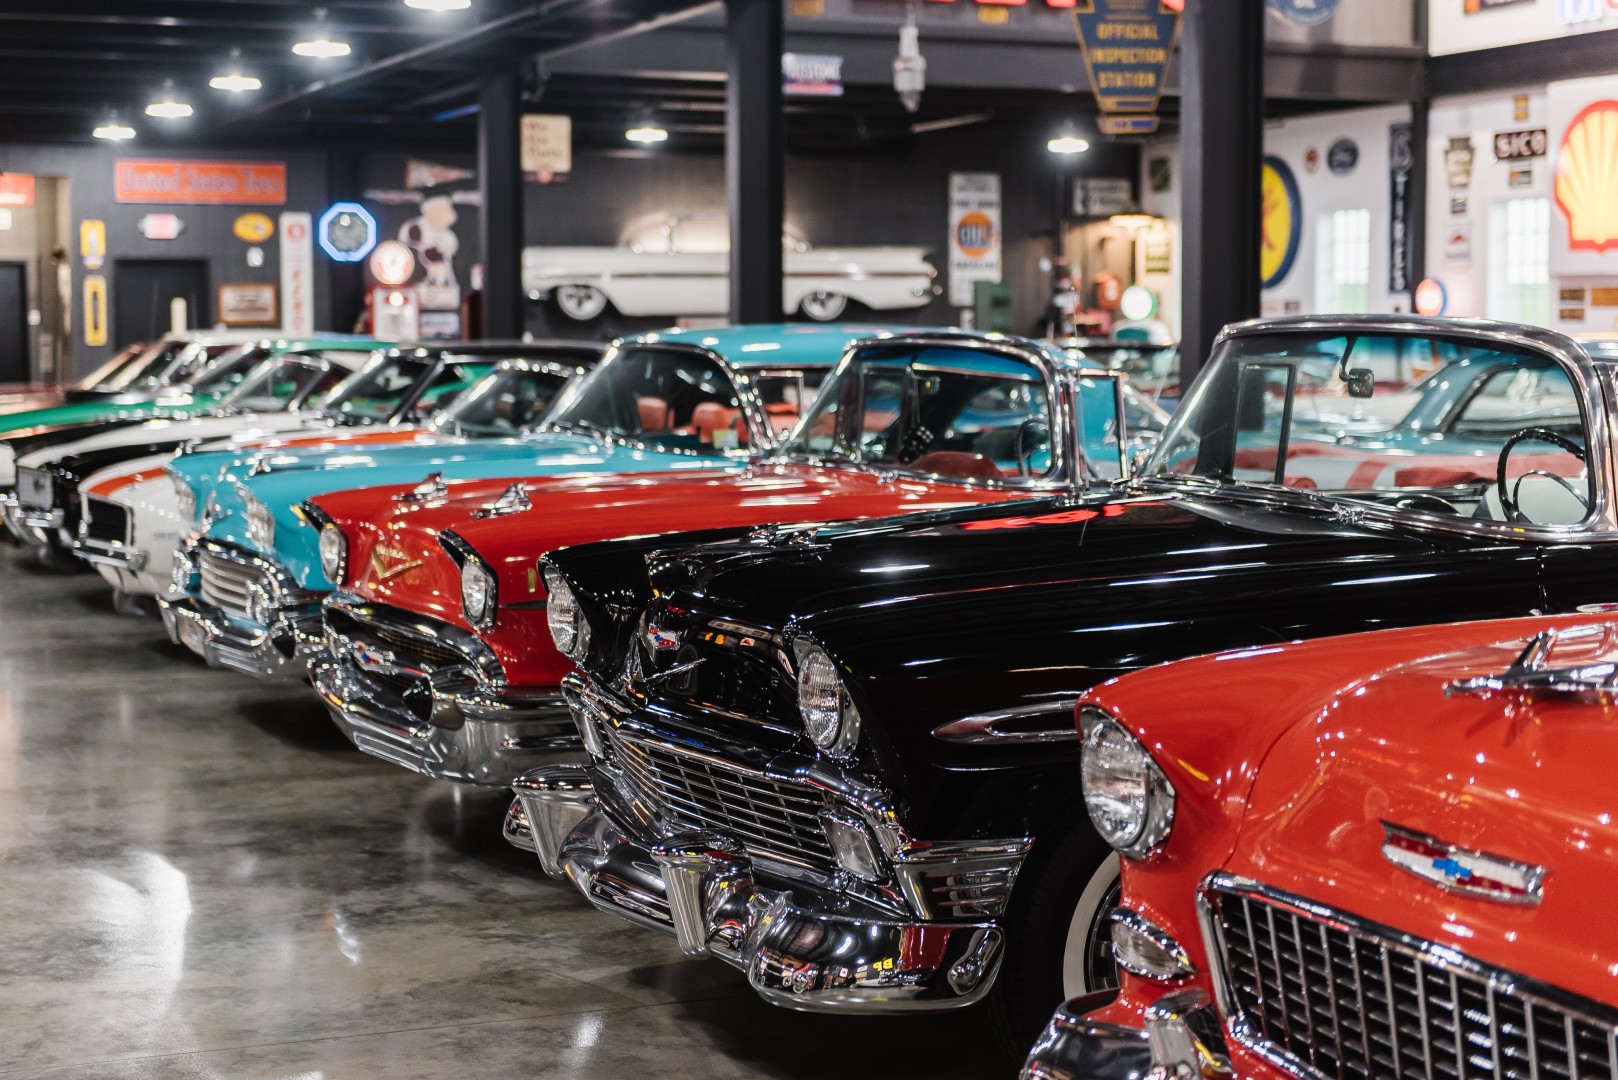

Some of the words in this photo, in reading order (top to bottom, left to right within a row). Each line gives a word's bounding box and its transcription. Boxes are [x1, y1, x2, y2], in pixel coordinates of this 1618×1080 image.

[1096, 23, 1160, 40] OFFICIAL
[1090, 47, 1167, 64] INSPECTION
[1098, 71, 1156, 88] STATION
[1495, 130, 1547, 158] SICO
[121, 165, 181, 192] United
[186, 166, 238, 193] States
[1392, 173, 1408, 291] TIRES
